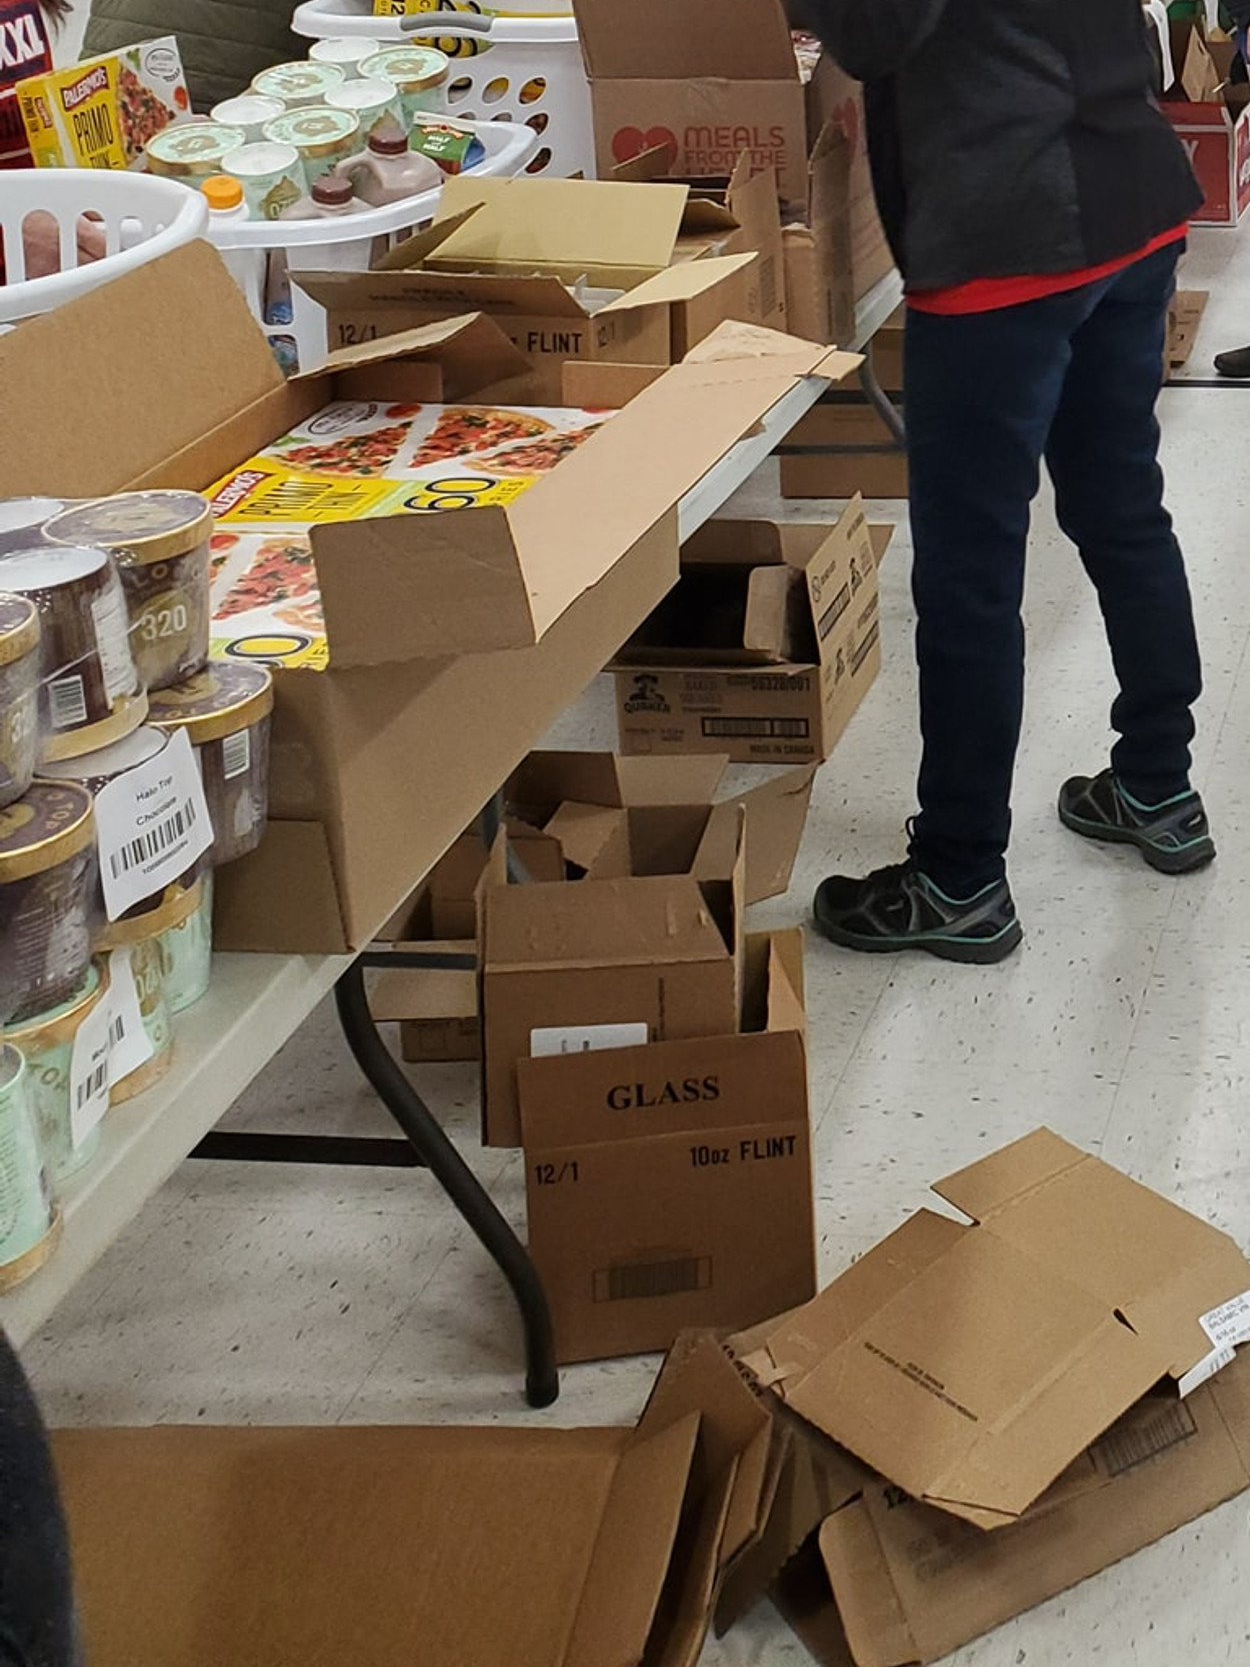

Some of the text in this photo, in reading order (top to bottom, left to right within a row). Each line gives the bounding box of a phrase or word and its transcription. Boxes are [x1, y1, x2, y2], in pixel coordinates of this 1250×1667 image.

[73, 103, 114, 156] PRIMO
[684, 126, 784, 148] MEALS
[528, 332, 583, 353] FLINT
[140, 604, 187, 641] 320
[606, 1076, 720, 1111] GLASS
[534, 1135, 797, 1186] 12/1 10oz FLINT
